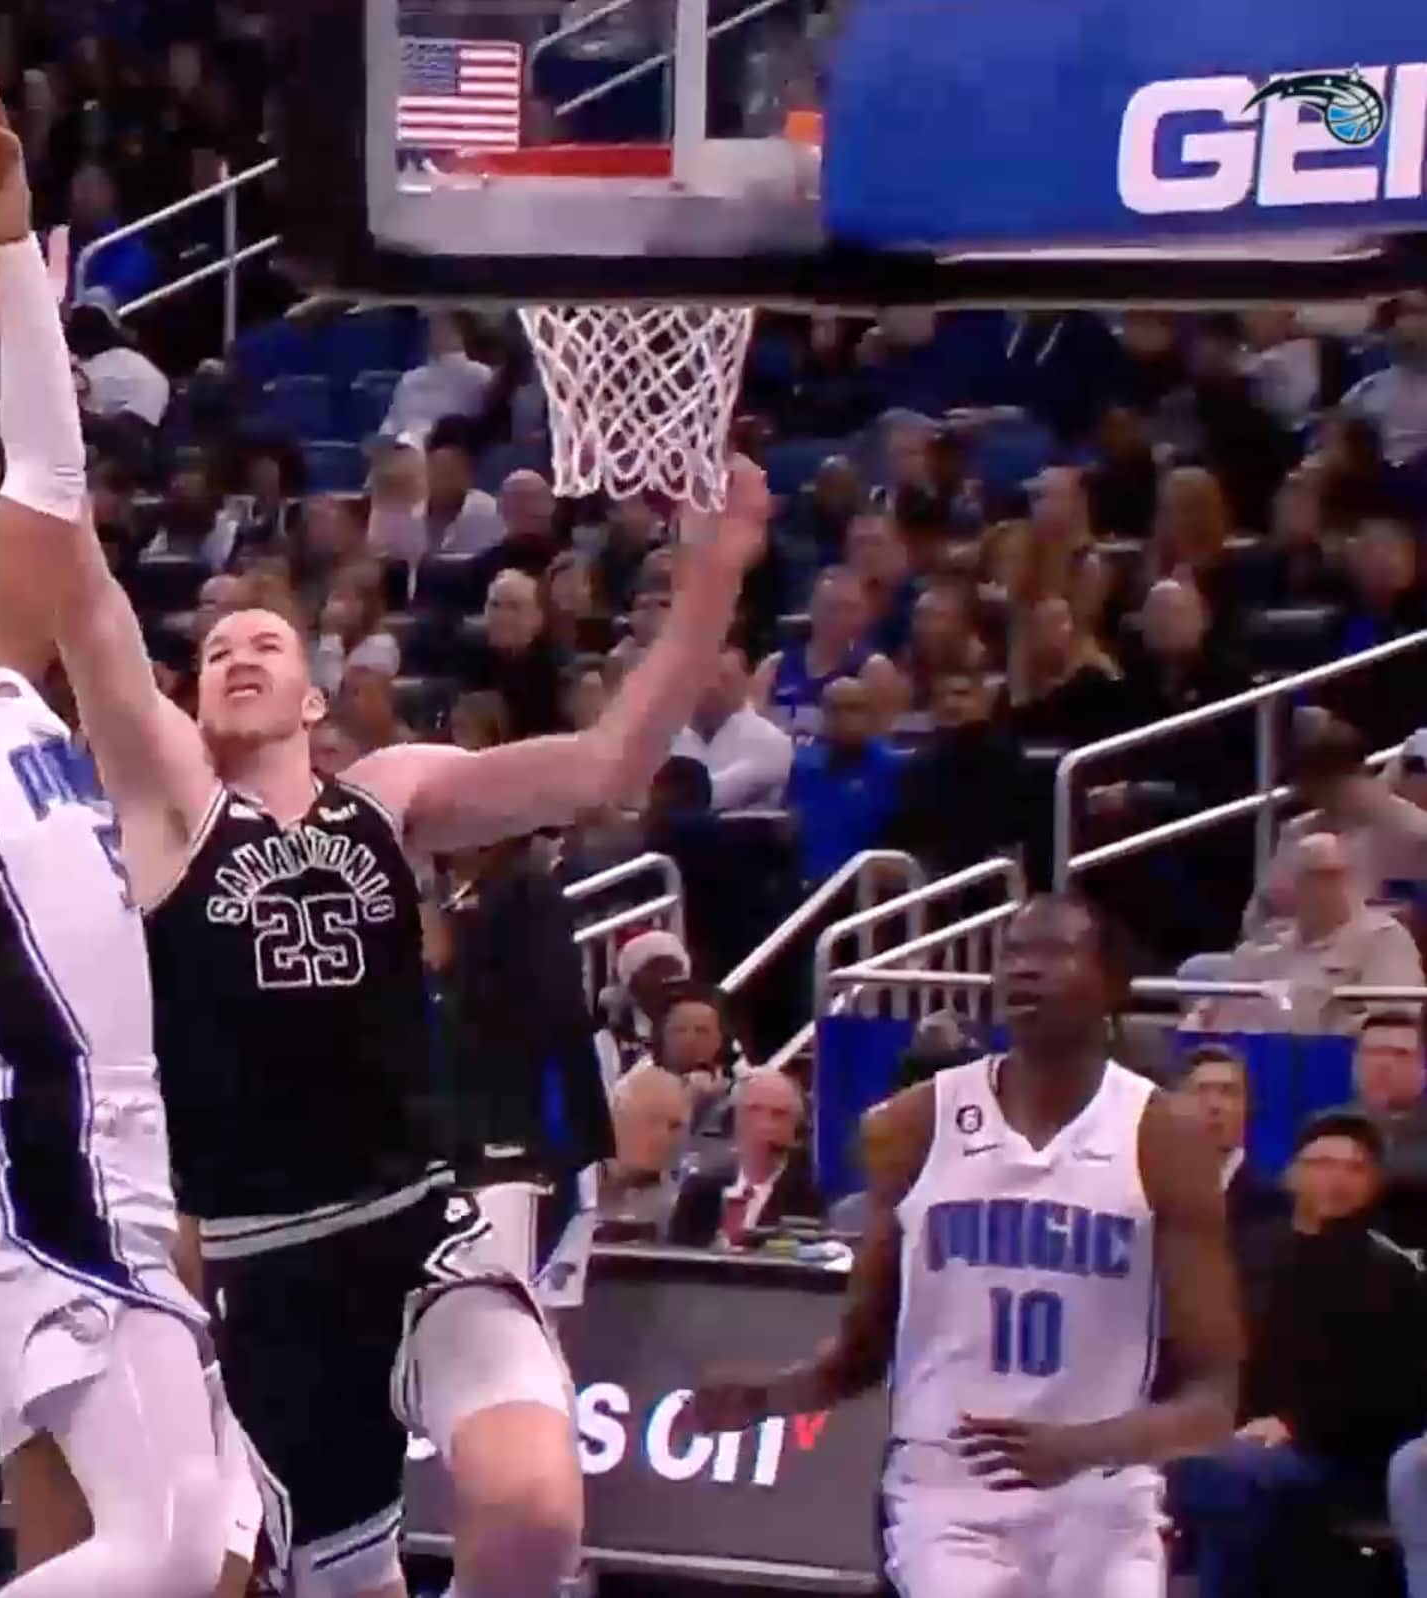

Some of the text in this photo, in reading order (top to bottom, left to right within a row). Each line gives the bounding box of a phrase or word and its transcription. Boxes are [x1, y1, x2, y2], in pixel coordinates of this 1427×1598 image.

[251, 893, 365, 988] 25
[926, 1198, 1136, 1279] MAGIC
[989, 1287, 1063, 1378] 10
